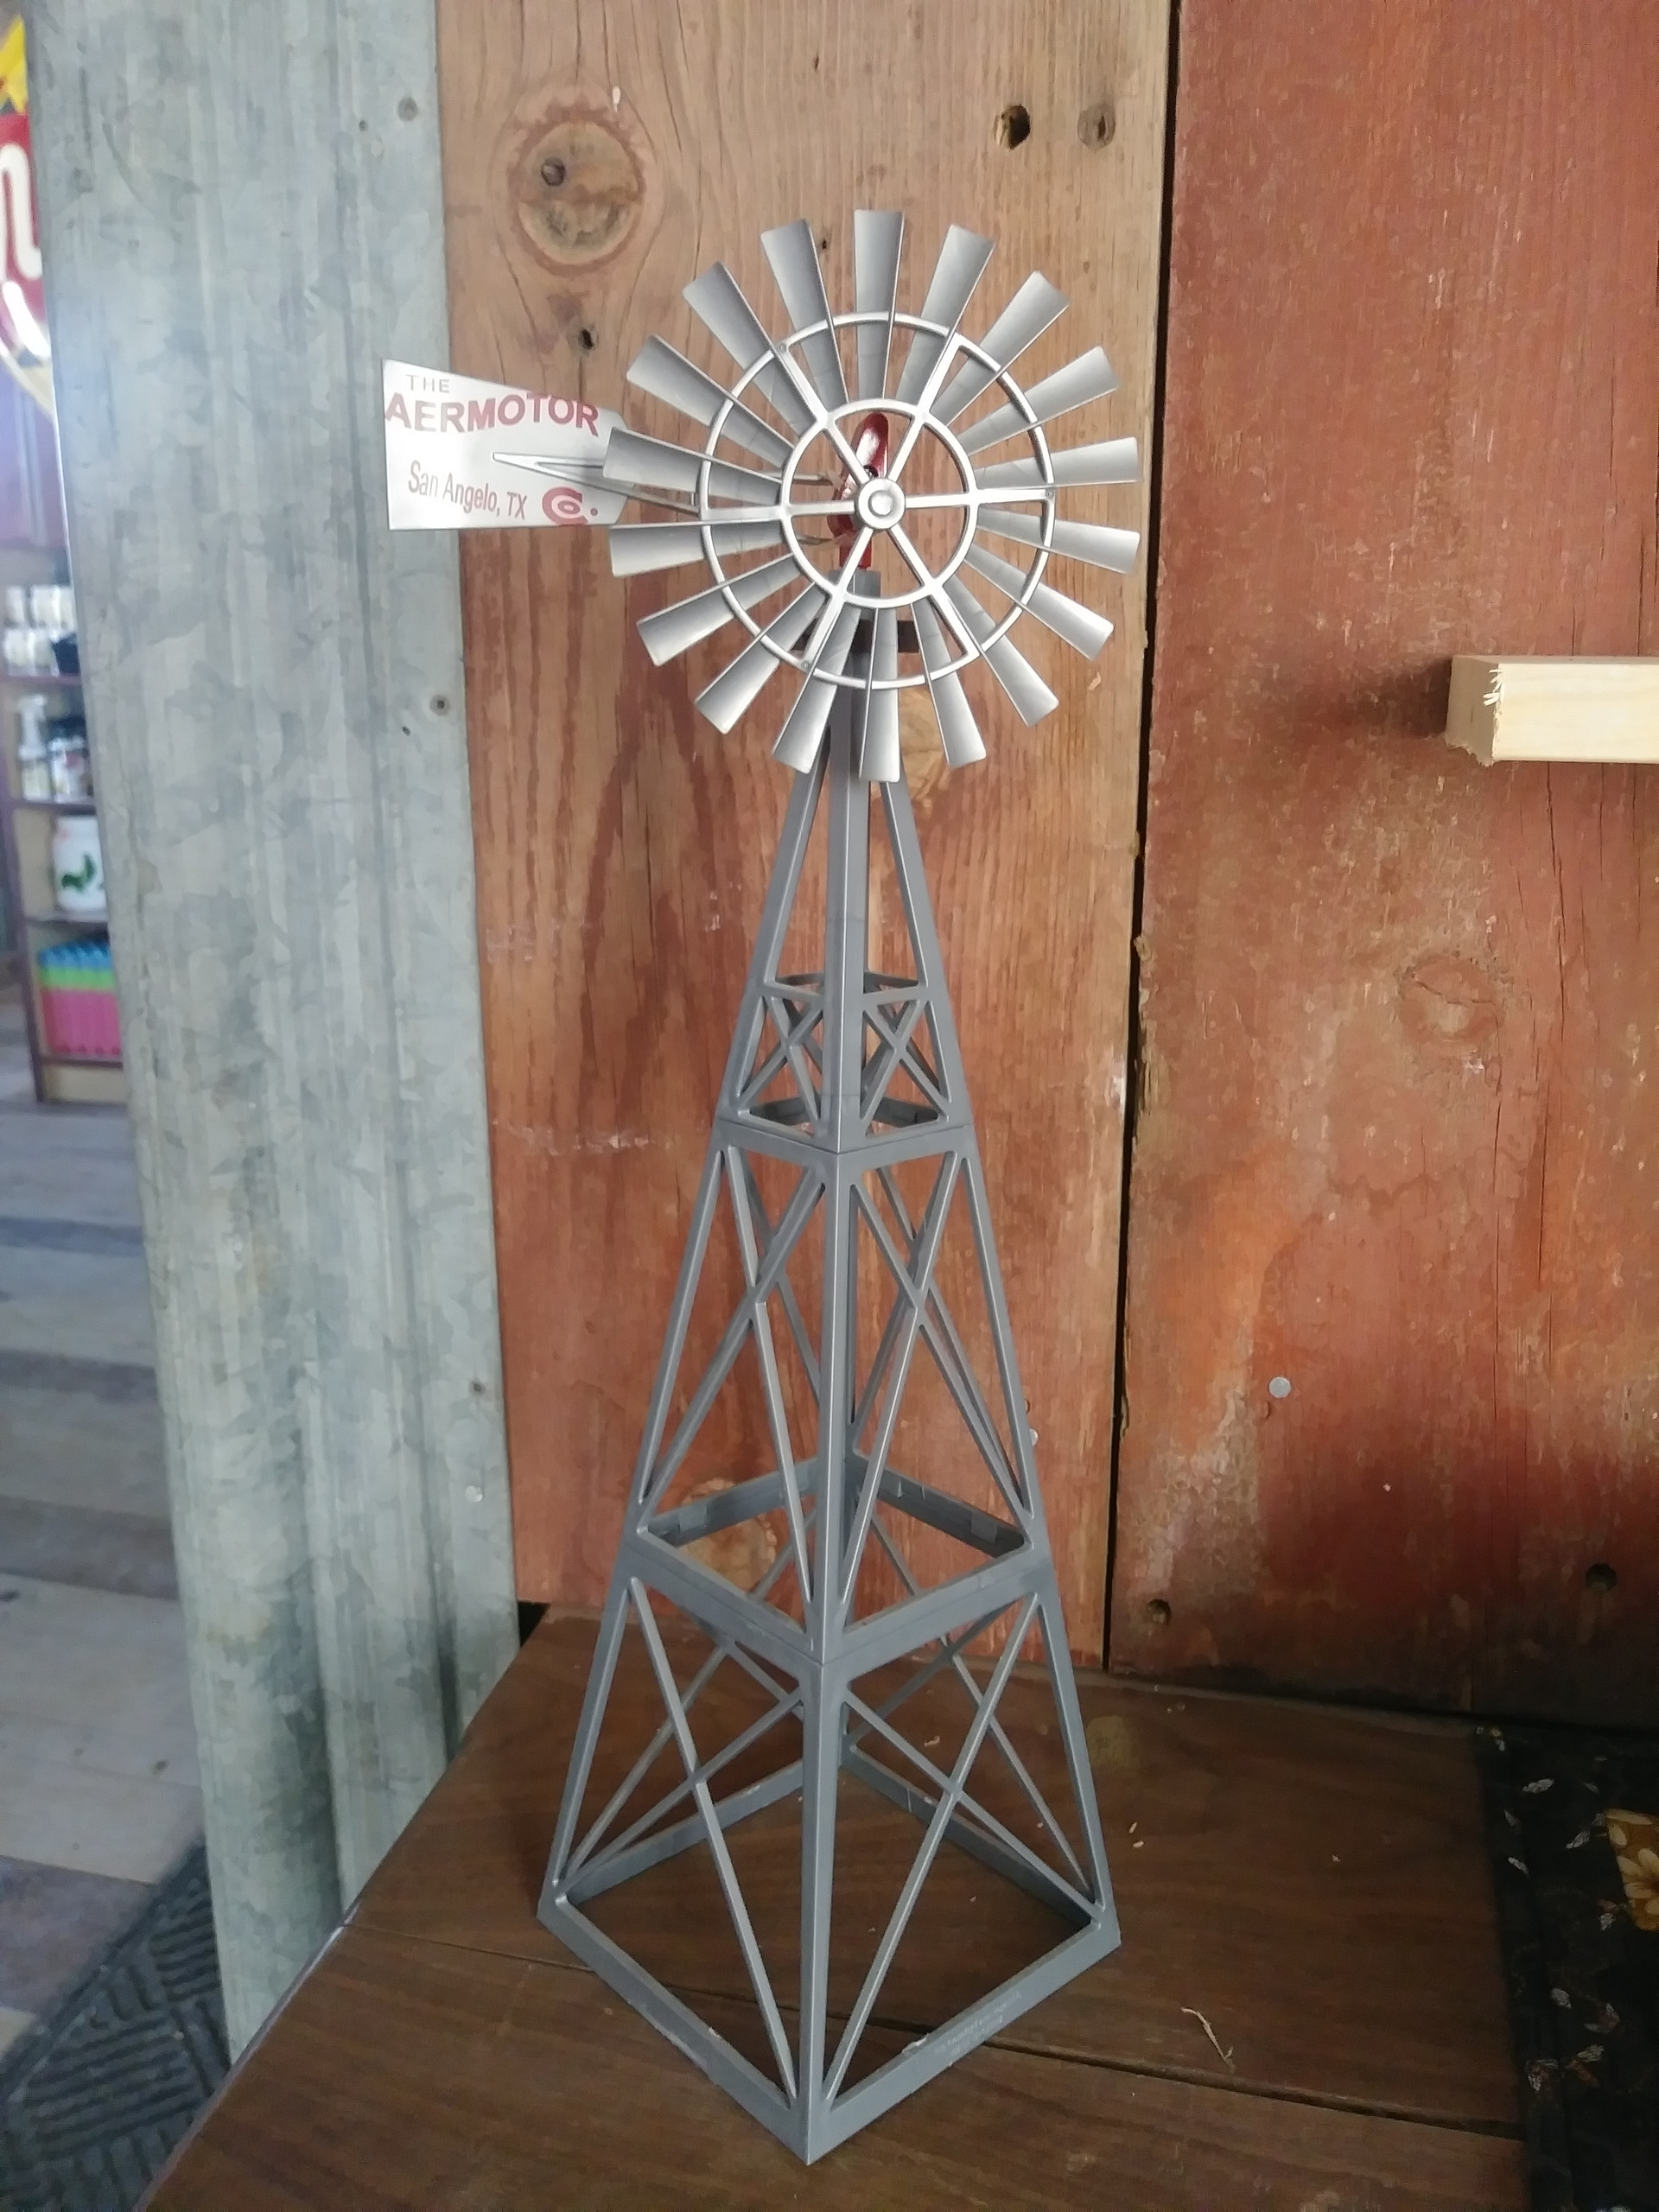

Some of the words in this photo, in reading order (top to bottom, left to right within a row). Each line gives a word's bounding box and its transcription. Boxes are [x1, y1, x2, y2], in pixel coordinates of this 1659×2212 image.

[406, 374, 449, 393] THE
[385, 392, 599, 436] AERMOTOR
[408, 461, 438, 498] San
[443, 473, 500, 517] Angelo,
[507, 492, 528, 520] TX
